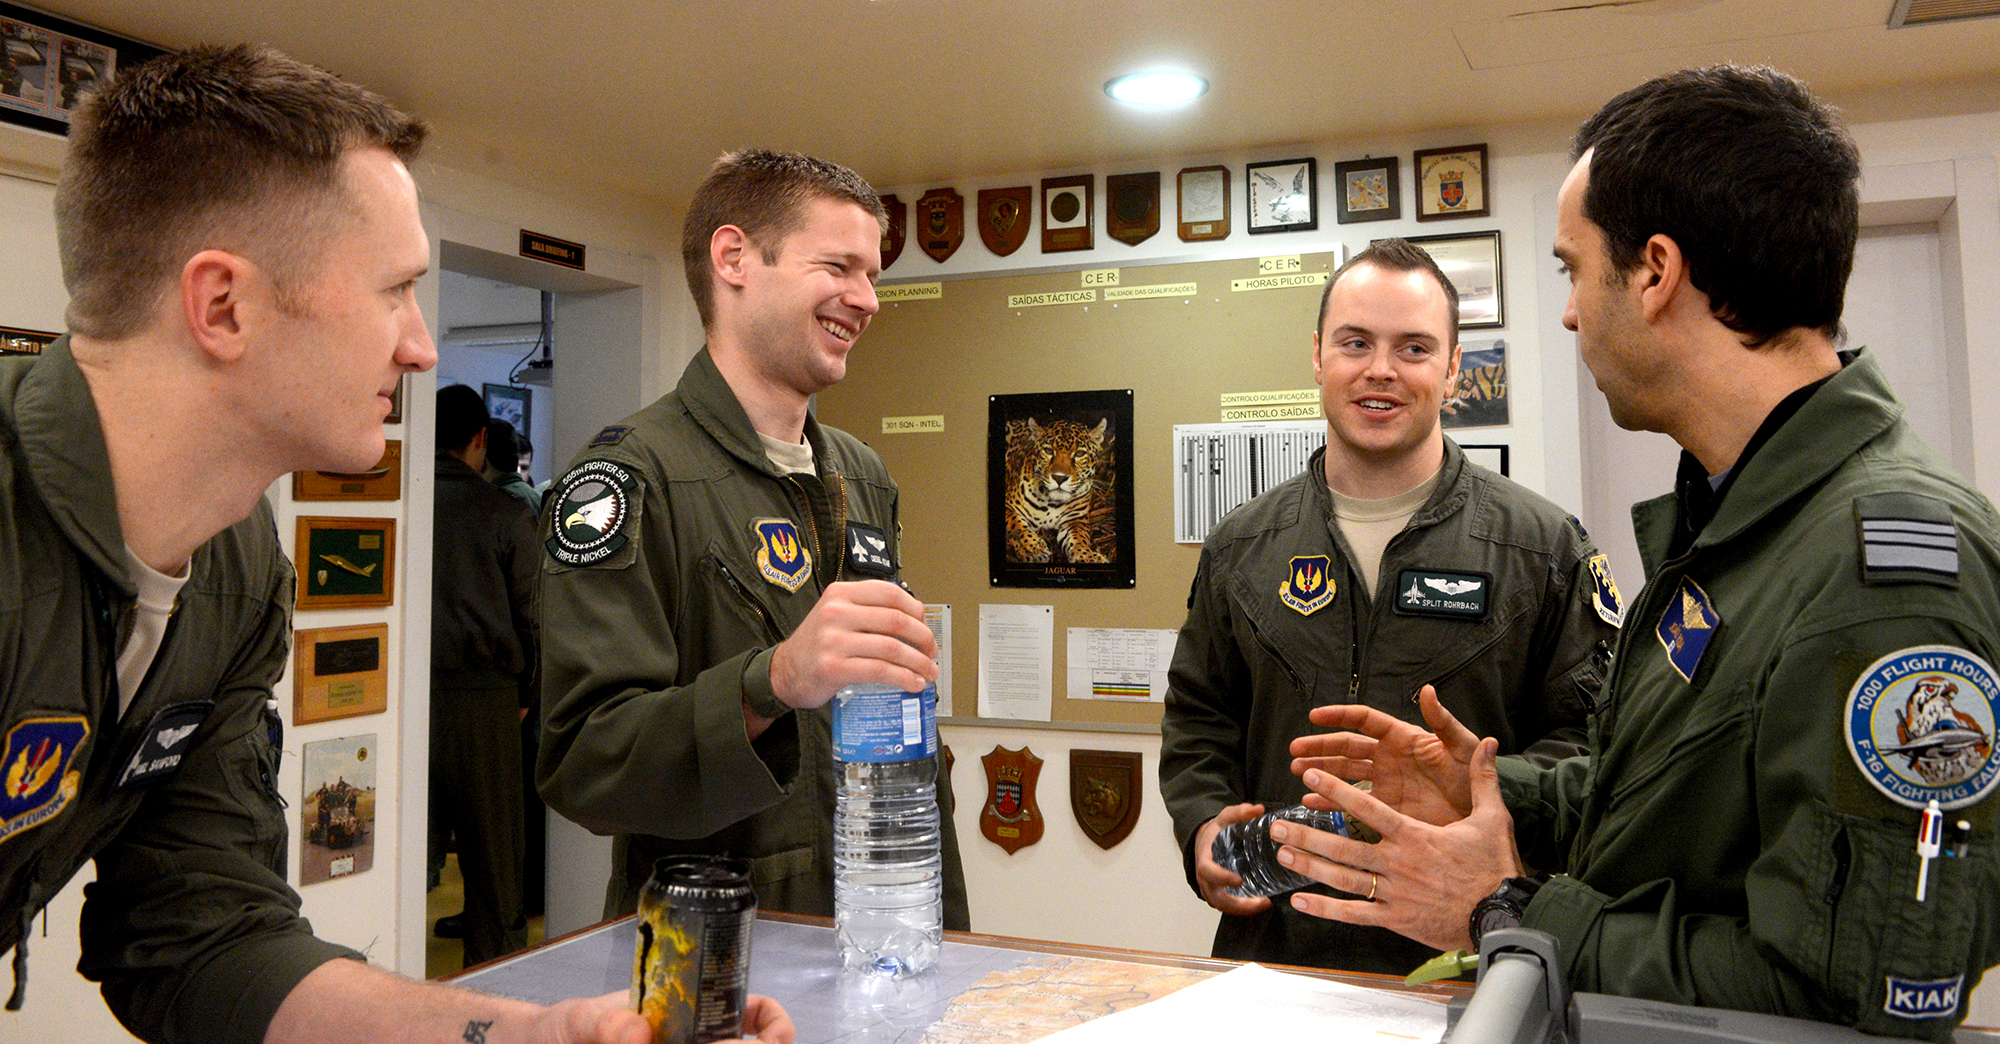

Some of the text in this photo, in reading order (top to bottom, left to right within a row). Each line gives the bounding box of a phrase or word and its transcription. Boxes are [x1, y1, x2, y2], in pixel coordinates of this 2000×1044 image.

[1246, 275, 1315, 289] HORAS PILOTO
[898, 286, 939, 297] PLANNING
[1106, 288, 1134, 297] VALIDADE
[1134, 287, 1147, 296] DAS
[1011, 294, 1045, 306] SAÍDAS
[1259, 392, 1315, 402] QUALIFICAÇÕES
[1226, 405, 1315, 420] CONTROLO SAÍDAS
[885, 421, 898, 429] 301
[898, 420, 915, 429] SQN
[919, 420, 941, 428] INTEL
[562, 460, 630, 486] 555TH FIGHTER SQ
[555, 546, 612, 564] TRIPLE NICKEL
[1044, 566, 1077, 575] JAGUAR
[1422, 599, 1480, 611] SPLIT ROHRBACH
[1857, 656, 2000, 712] 1000 FLIGHT HOURS
[1857, 738, 1885, 775] F-16
[1881, 772, 1969, 801] FIGHTING
[25, 791, 67, 826] EUROPE
[1894, 986, 1956, 1010] KIAK
